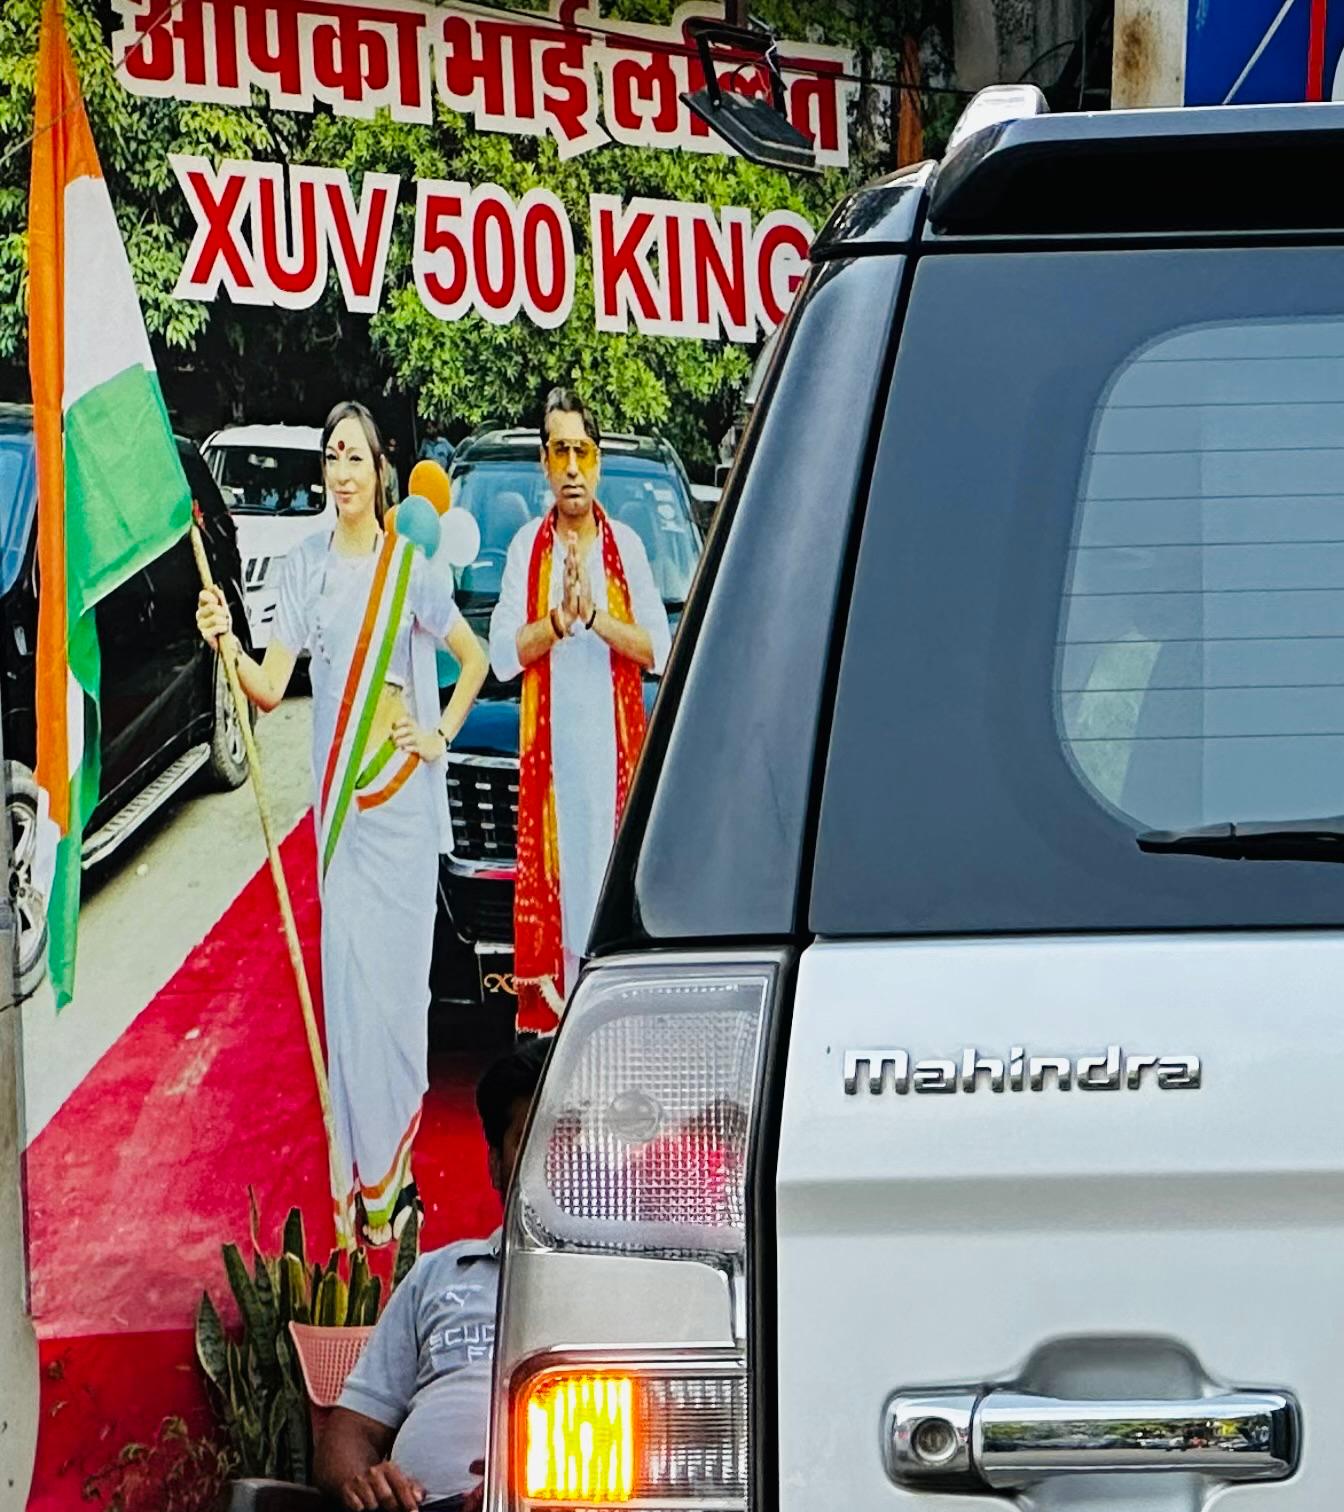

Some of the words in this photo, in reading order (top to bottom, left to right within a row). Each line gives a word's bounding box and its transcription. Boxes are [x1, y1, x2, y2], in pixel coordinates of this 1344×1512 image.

[125, 0, 426, 108] आपका
[443, 0, 593, 141] भाई
[187, 170, 389, 297] XUV
[422, 194, 566, 313] 500
[600, 208, 808, 327] KING
[842, 1046, 1202, 1095] Mahindra
